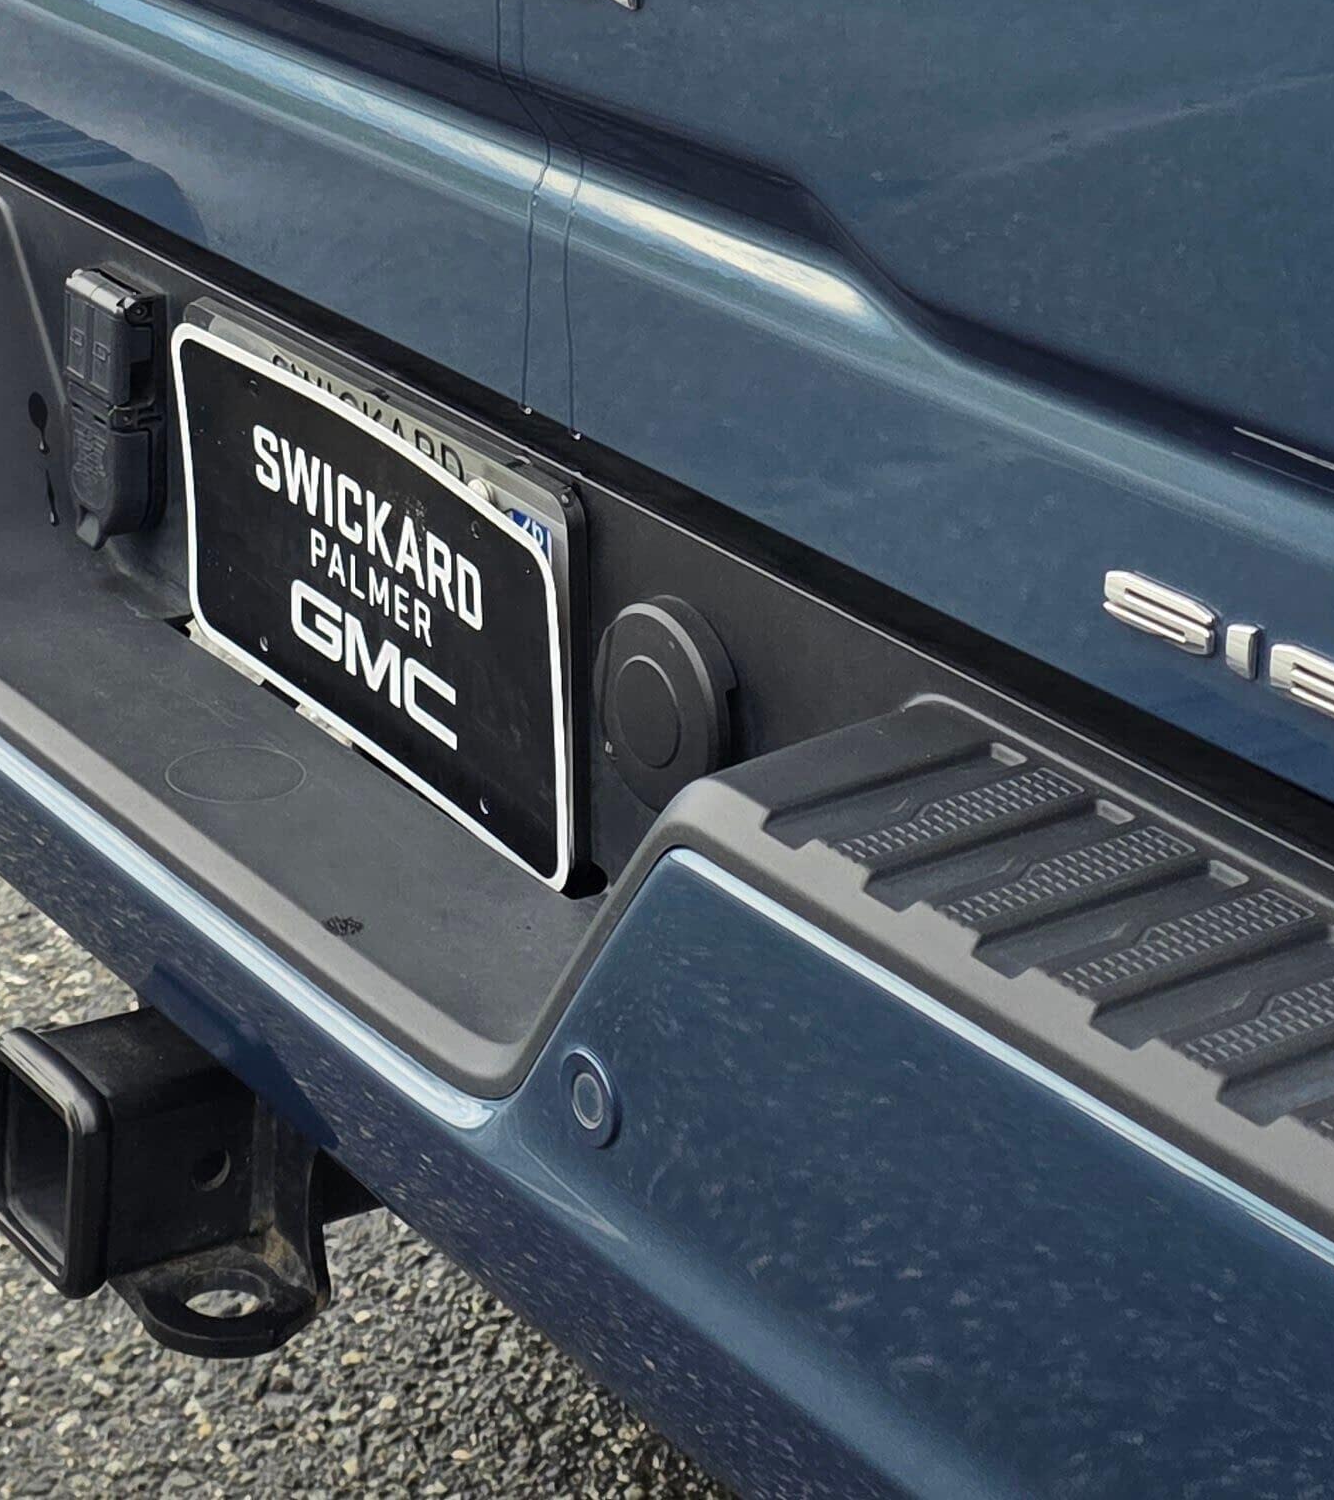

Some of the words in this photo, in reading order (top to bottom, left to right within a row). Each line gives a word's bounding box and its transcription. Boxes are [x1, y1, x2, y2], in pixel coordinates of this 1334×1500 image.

[252, 424, 483, 632] SWICKARD
[310, 527, 433, 648] PALMER
[290, 578, 458, 751] GMC
